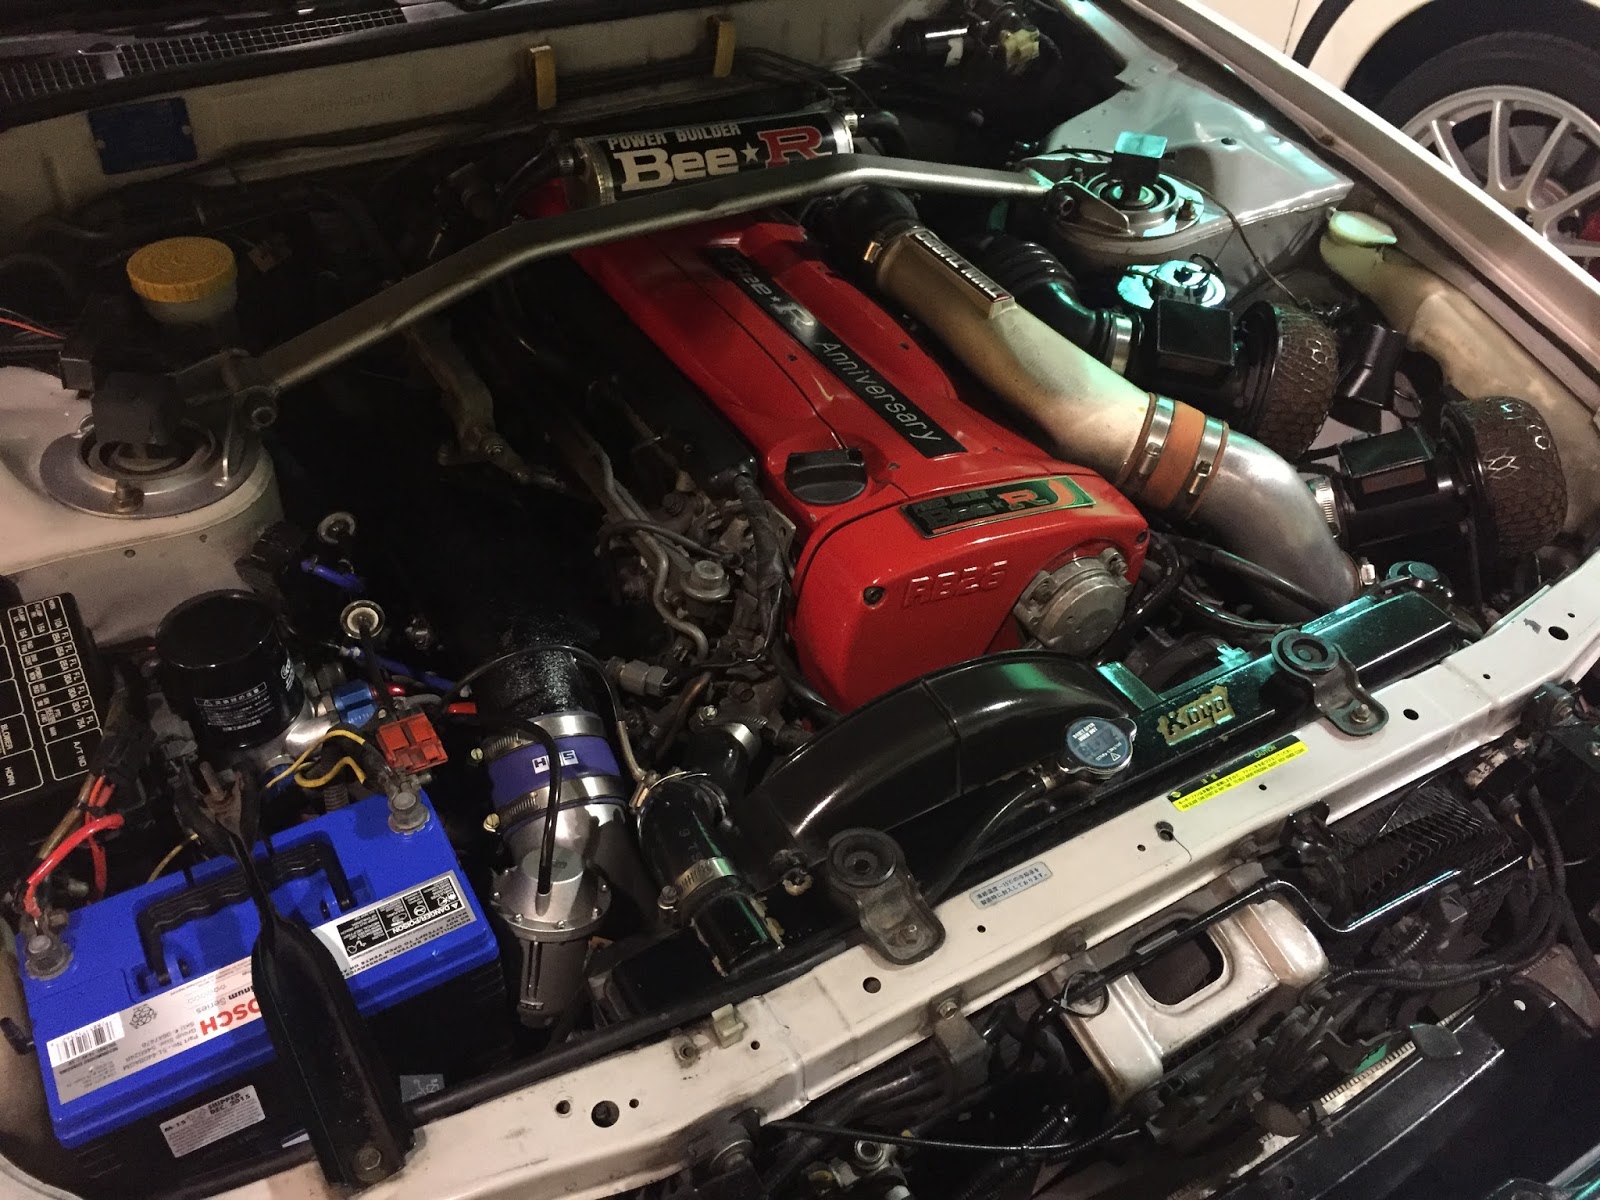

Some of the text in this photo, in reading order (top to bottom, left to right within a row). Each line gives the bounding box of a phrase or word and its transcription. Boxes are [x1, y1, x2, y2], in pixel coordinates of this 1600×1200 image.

[608, 123, 742, 150] POWER BUILDER
[613, 147, 740, 192] Bee
[915, 231, 962, 268] TURBO
[814, 341, 941, 443] Anniversary
[903, 562, 1009, 605] RB26
[54, 618, 63, 628] 10A
[61, 632, 68, 640] FL
[65, 645, 73, 653] FL
[69, 658, 77, 667] FL
[74, 671, 82, 680] FL
[77, 685, 86, 695] FL
[81, 699, 89, 709] FL
[86, 716, 94, 725] FL
[1164, 697, 1228, 735] Koyo
[0, 723, 14, 750] BLOWER
[72, 740, 85, 756] A/T
[1254, 746, 1277, 759] CAUTION
[534, 751, 575, 768] HS
[4, 766, 16, 786] HORN
[392, 905, 451, 933] DANGER/POISON
[446, 919, 458, 927] NOT
[415, 926, 443, 941] ATTEMPT
[423, 919, 471, 941] NONSPILLABLE
[383, 944, 402, 957] OPEN
[195, 985, 254, 1015] inum Series
[198, 998, 261, 1035] OSCH
[180, 1021, 195, 1031] SKU
[175, 1027, 197, 1041] Group
[184, 1034, 198, 1044] Part
[207, 1091, 241, 1109] SHIPPED
[230, 1093, 251, 1106] 2015
